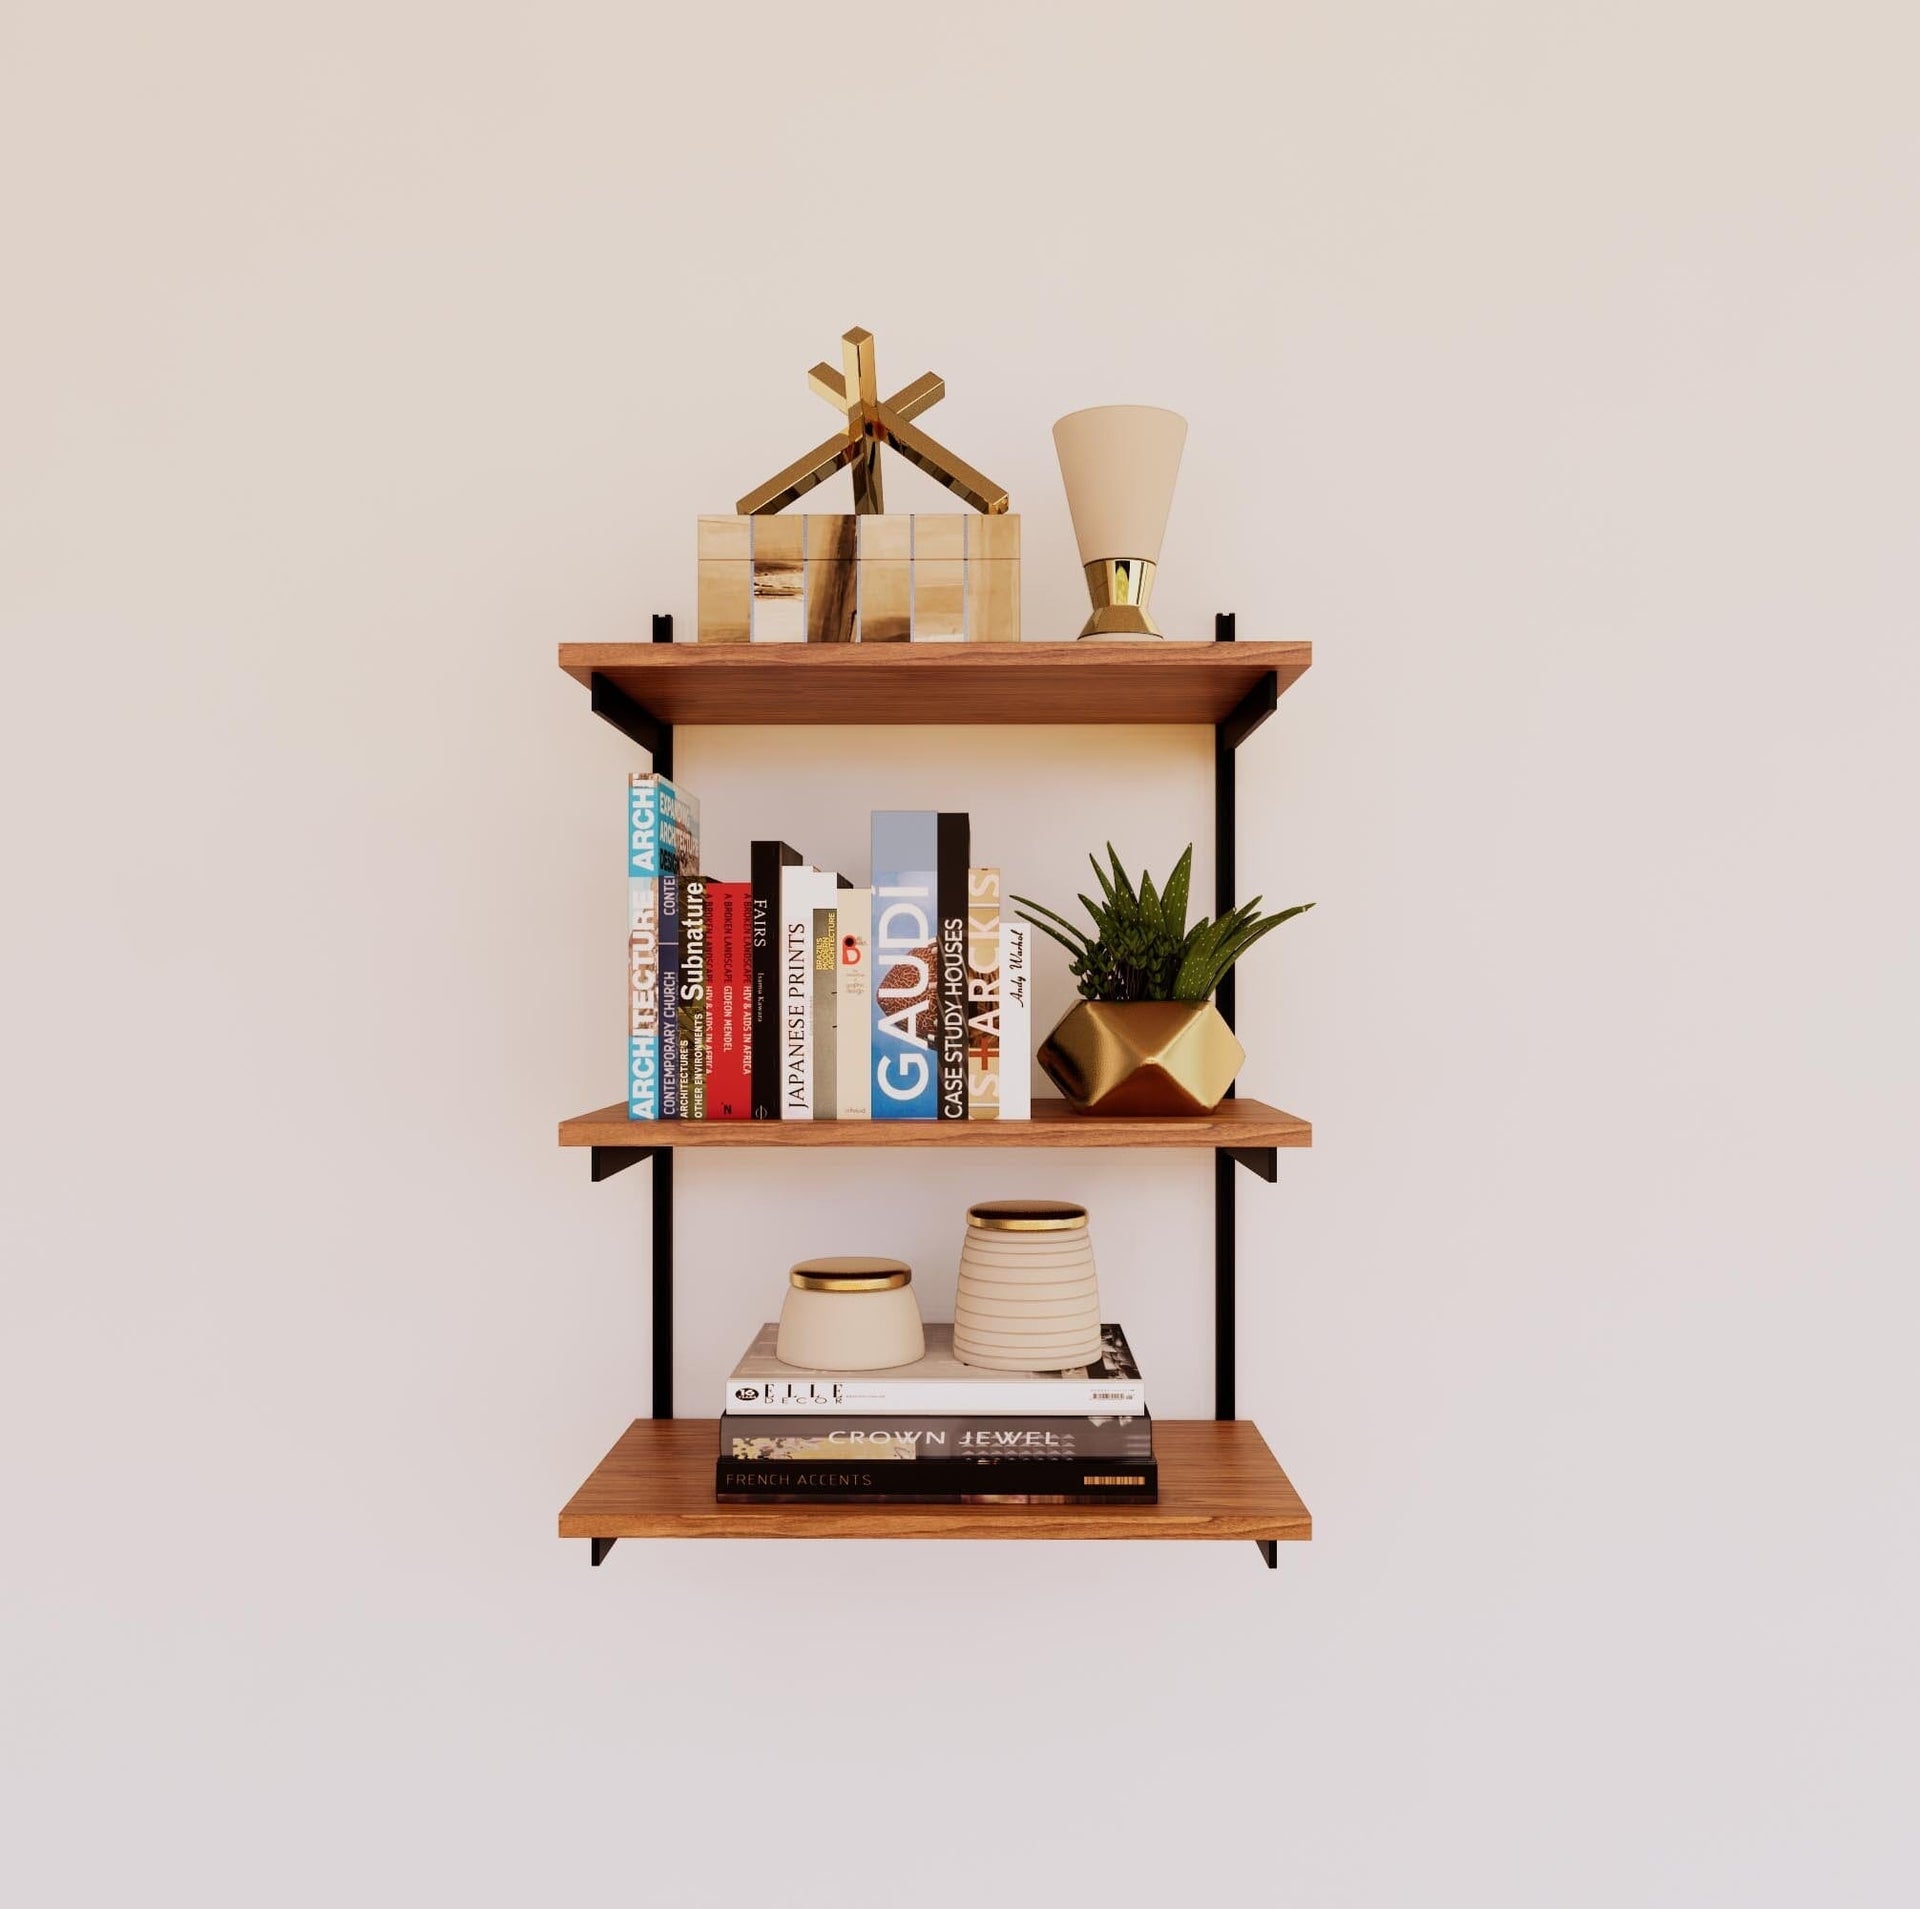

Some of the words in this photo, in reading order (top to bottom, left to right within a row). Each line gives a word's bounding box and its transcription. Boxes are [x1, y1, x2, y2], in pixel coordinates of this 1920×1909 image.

[663, 875, 676, 916] CONTE
[723, 901, 733, 935] BROKEN
[754, 899, 767, 947] FAIRS
[681, 882, 704, 1001] Subnature
[723, 936, 733, 983] LANDSCAPE
[945, 918, 962, 996] HOUSES
[1009, 929, 1024, 970] Warhol
[788, 923, 805, 998] PRINTS
[663, 971, 676, 1018] CHURCH
[723, 986, 733, 1017] GIDEON
[743, 986, 752, 1000] HIV
[1009, 976, 1026, 1008] Andy
[723, 1019, 733, 1053] MENDEL
[743, 1011, 752, 1031] AIDS
[743, 1034, 752, 1043] IN
[945, 1000, 962, 1062] STUDY
[694, 1013, 703, 1085] ENVIRONMENTS
[743, 1045, 752, 1075] AFRICA
[789, 1005, 809, 1109] JAPANESE
[663, 1022, 676, 1115] CONTEMPORARY
[694, 1087, 703, 1119] OTHER
[945, 1067, 962, 1118] CASE
[765, 1384, 842, 1398] ELLE
[765, 1396, 842, 1404] DECOR
[828, 1431, 946, 1445] CROWN
[958, 1431, 1059, 1445] JEWEL
[726, 1474, 789, 1486] FRENCH
[797, 1474, 872, 1486] ACCENTS
